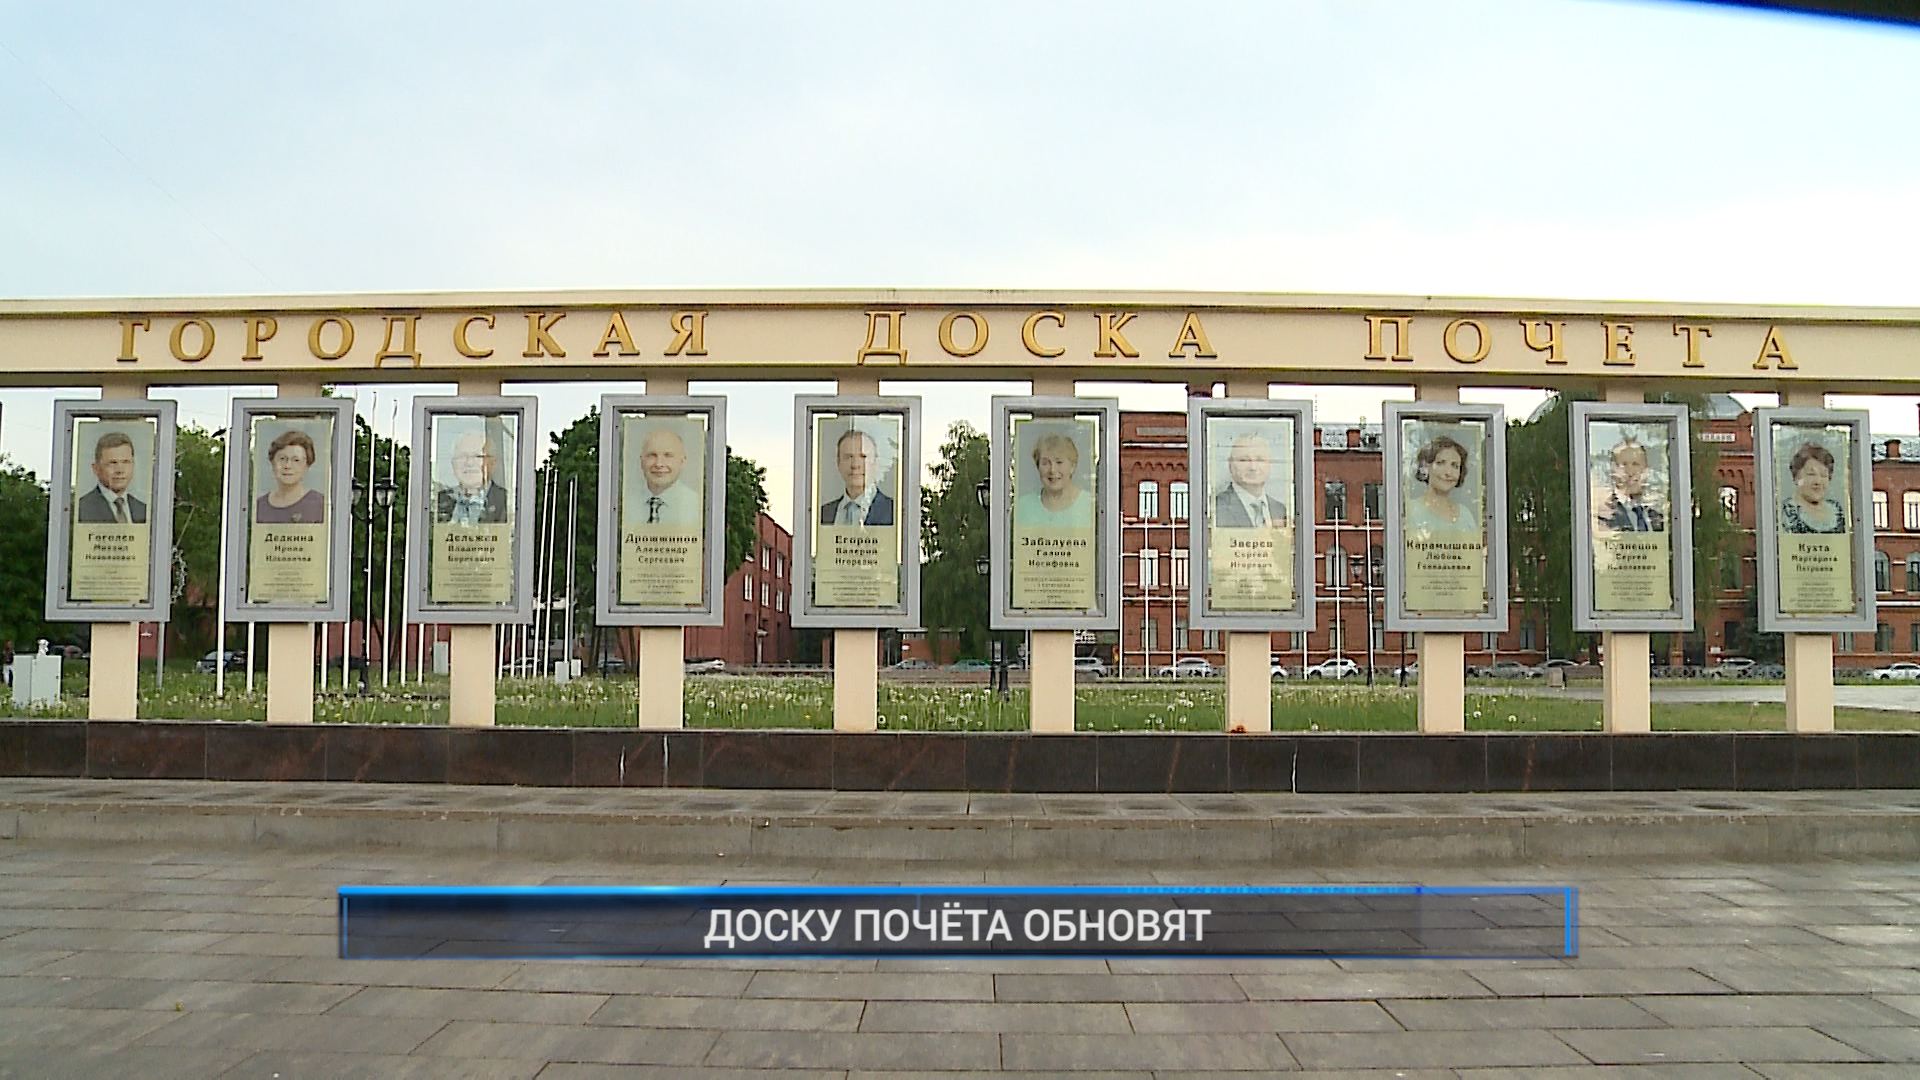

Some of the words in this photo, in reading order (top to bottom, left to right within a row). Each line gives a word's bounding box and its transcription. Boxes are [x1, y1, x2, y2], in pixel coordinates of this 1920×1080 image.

[116, 310, 709, 369] ГОРОДСКАЯ
[857, 309, 1218, 367] ДОСКА
[1363, 314, 1799, 369] ПОЧЕТА
